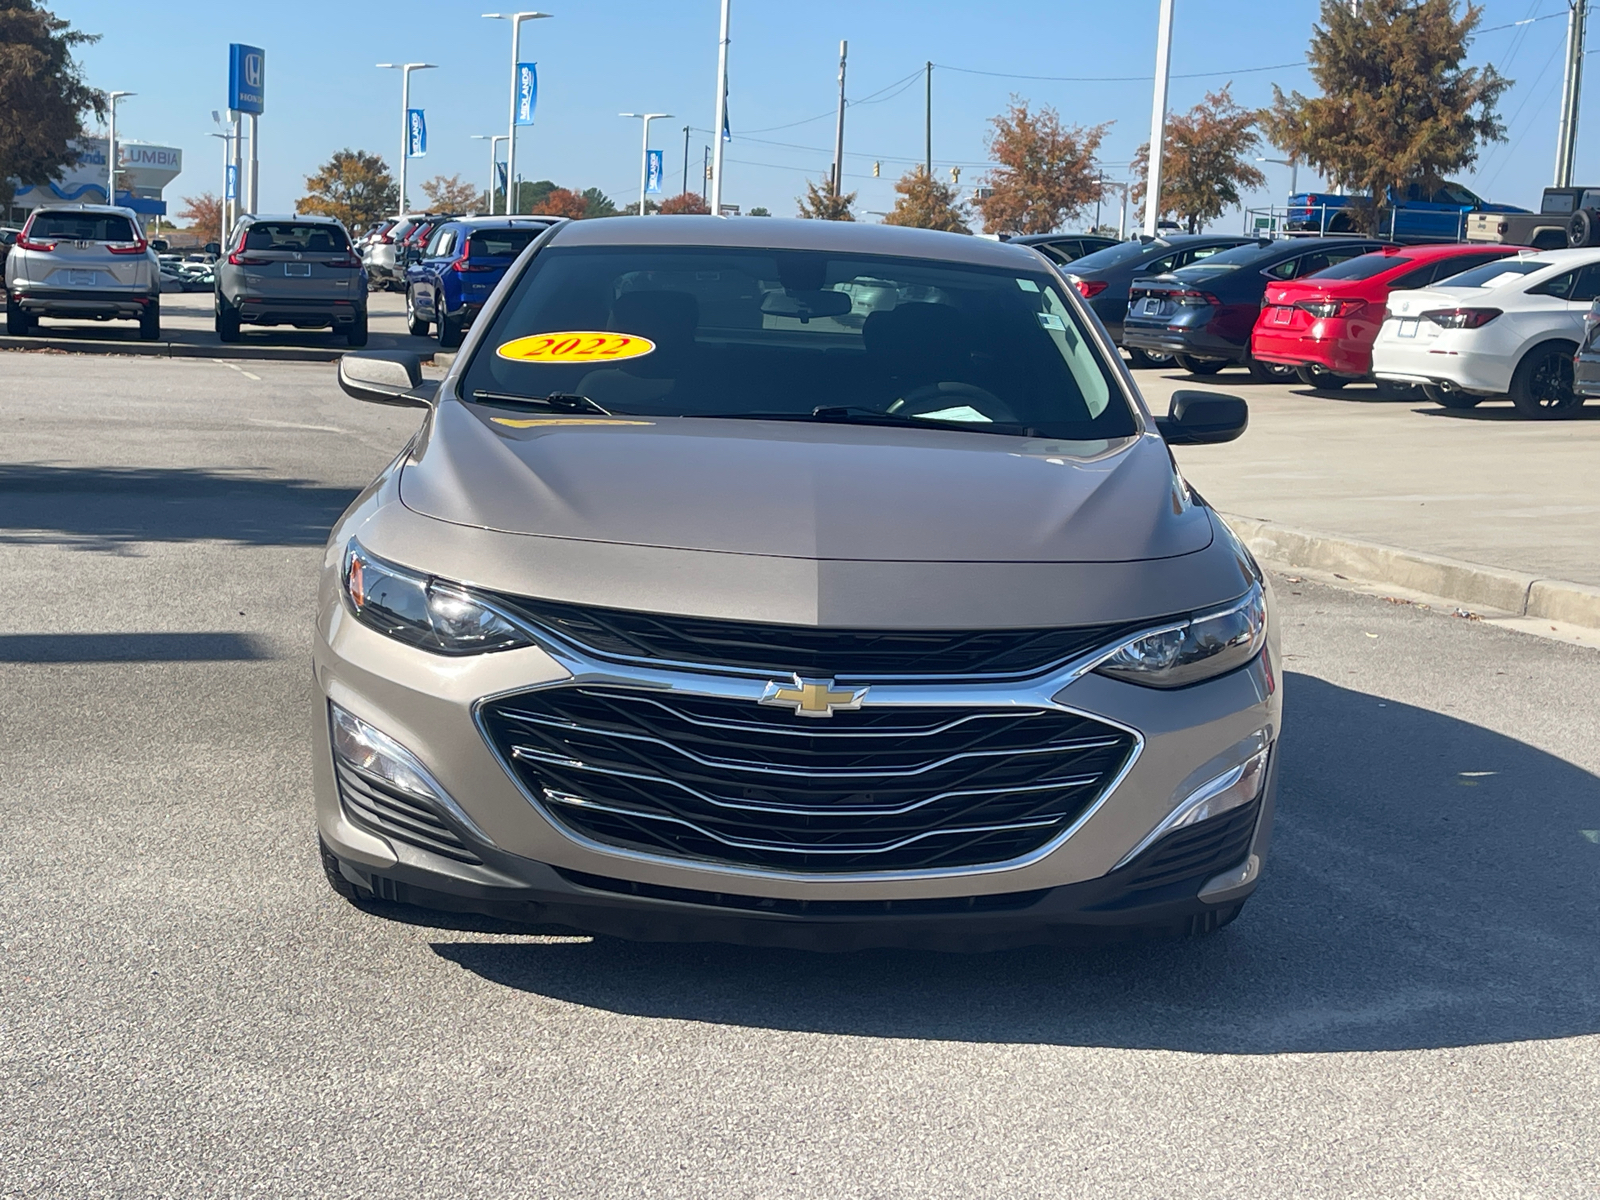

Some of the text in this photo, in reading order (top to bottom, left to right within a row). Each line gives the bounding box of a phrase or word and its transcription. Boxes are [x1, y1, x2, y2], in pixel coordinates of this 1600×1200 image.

[239, 92, 263, 104] HOND
[520, 66, 529, 120] MIDLANDS
[522, 338, 630, 357] 2022
